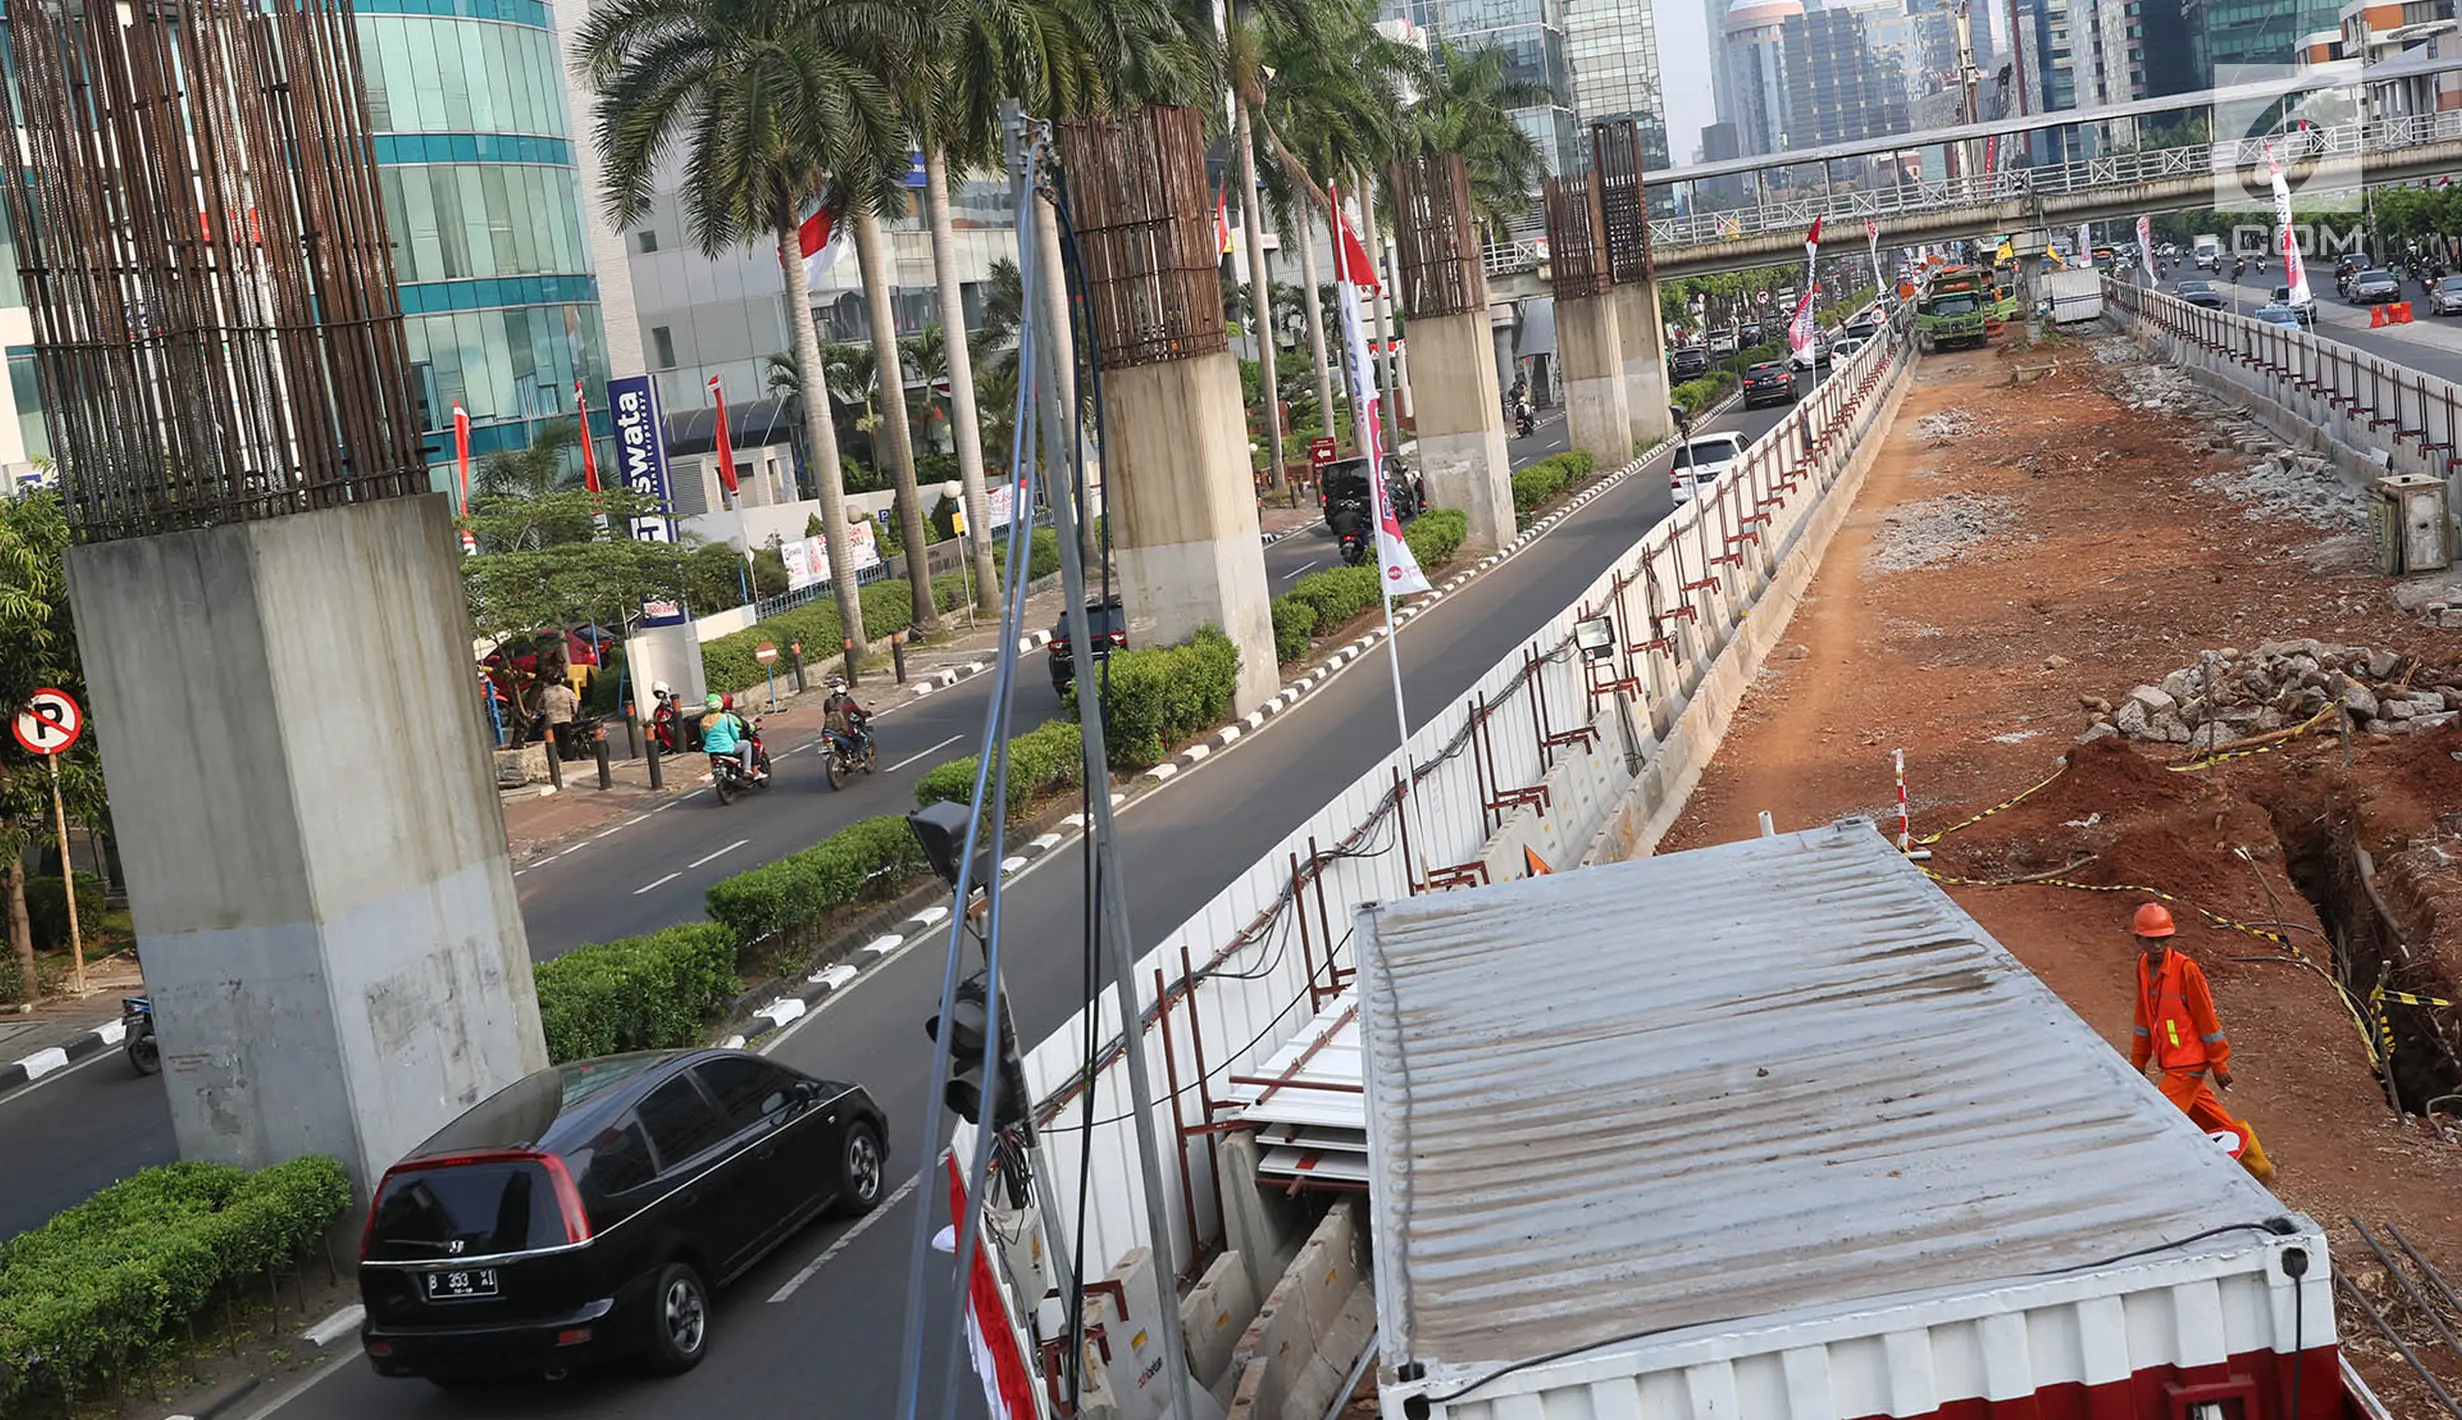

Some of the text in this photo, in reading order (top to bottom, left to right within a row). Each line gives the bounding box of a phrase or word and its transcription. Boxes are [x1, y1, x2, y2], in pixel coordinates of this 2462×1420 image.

[617, 391, 655, 512] swata
[880, 510, 889, 520] P
[34, 702, 63, 740] P
[429, 1274, 438, 1290] B
[448, 1271, 469, 1288] 353
